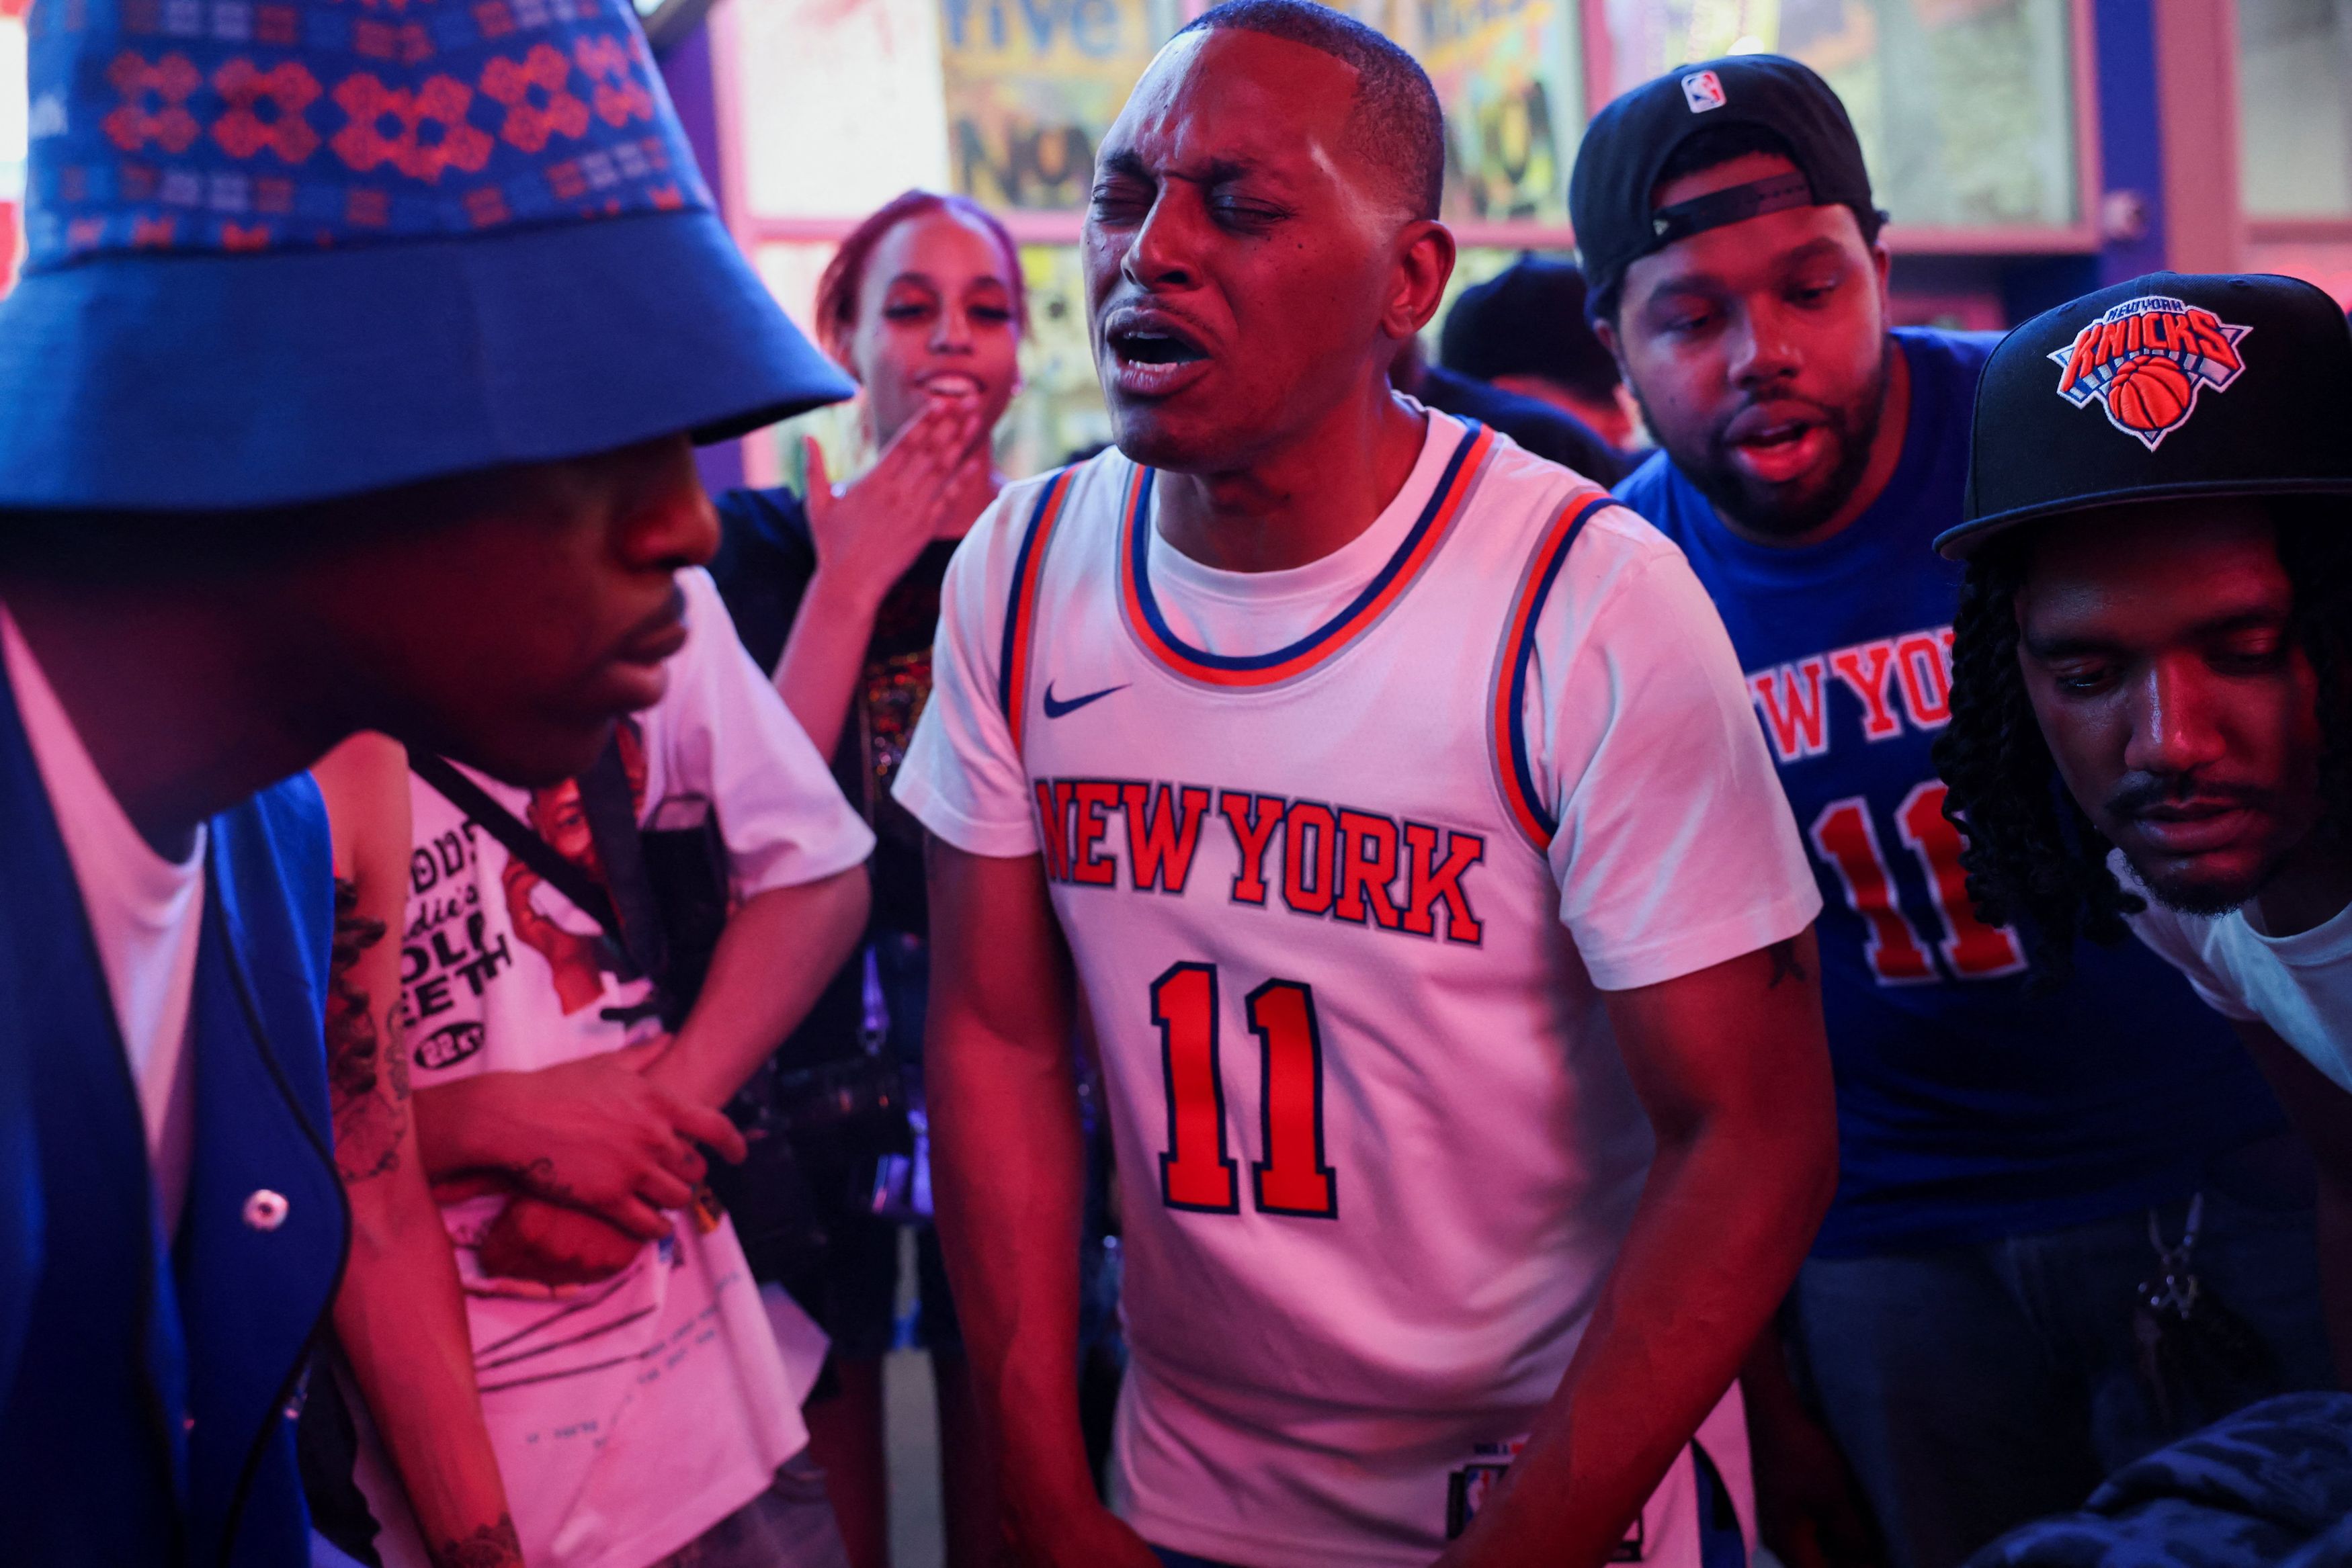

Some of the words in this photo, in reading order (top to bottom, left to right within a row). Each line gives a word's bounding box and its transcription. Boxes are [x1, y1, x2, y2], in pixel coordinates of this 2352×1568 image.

[2061, 308, 2242, 393] KNICKS
[2106, 300, 2141, 322] NEW
[2142, 298, 2183, 314] YORK
[1745, 654, 1830, 765] W
[1829, 625, 1956, 742] YO
[1036, 777, 1211, 895] NEW
[1218, 789, 1485, 949] YORK
[1810, 778, 2029, 988] 11
[1149, 960, 1339, 1221] 11
